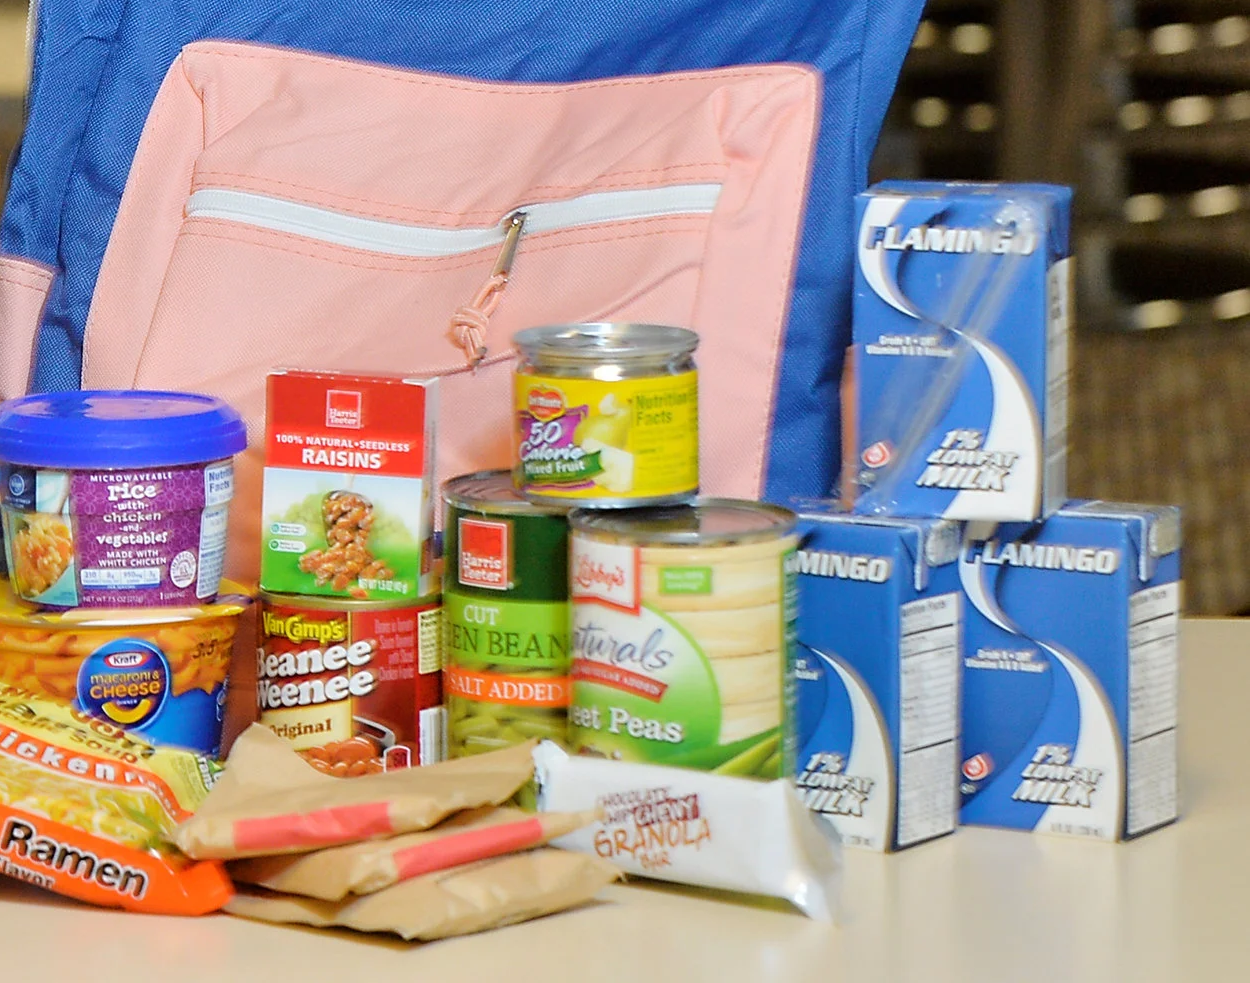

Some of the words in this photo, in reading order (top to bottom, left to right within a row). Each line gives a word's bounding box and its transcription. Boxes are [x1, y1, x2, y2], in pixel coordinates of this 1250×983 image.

[329, 407, 358, 418] Harris
[276, 433, 303, 445] 100%
[530, 421, 562, 445] 50
[302, 448, 381, 469] RAISINS
[90, 472, 173, 483] MICROWAVEABLE
[915, 465, 1011, 492] MILK
[108, 483, 157, 503] rice
[103, 511, 162, 523] chicken
[96, 532, 168, 548] vegetables
[98, 558, 128, 567] WHITE
[130, 557, 168, 567] CHICKEN
[106, 550, 133, 559] MADE
[136, 549, 159, 558] WITH
[462, 551, 502, 569] Harris
[964, 539, 1119, 576] FLAMINGO
[462, 567, 502, 582] Teeter
[463, 604, 499, 626] CUT
[113, 653, 139, 666] Kraft
[90, 671, 152, 685] macaroni
[152, 671, 160, 682] &
[449, 673, 485, 697] SALT
[488, 679, 564, 702] ADDED
[609, 706, 683, 743] Peas
[1020, 762, 1104, 786] LOWFAT
[1011, 778, 1100, 809] MILK
[593, 817, 712, 859] GRANOLA
[640, 852, 672, 870] BAR
